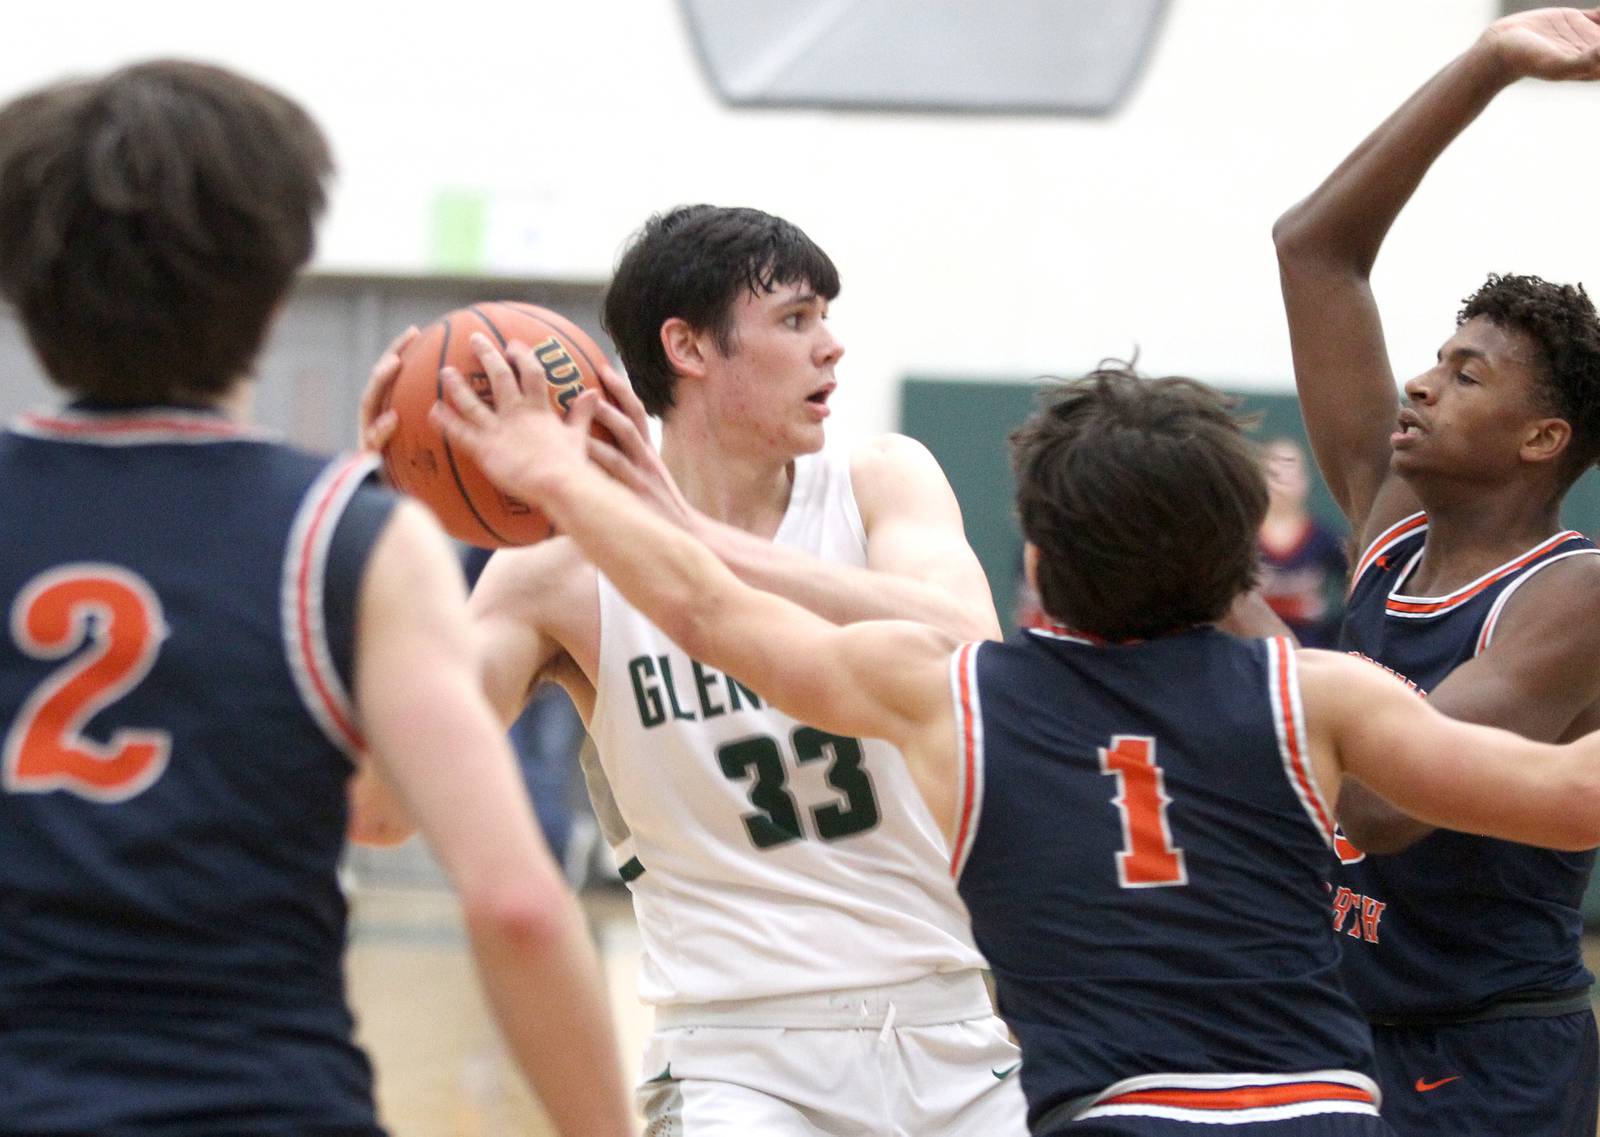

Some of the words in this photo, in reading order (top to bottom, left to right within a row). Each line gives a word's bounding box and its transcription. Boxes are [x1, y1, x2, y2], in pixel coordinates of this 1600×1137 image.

[2, 561, 172, 804] 2
[715, 725, 883, 851] 33
[1098, 735, 1189, 888] 1
[1322, 882, 1387, 944] RTH
